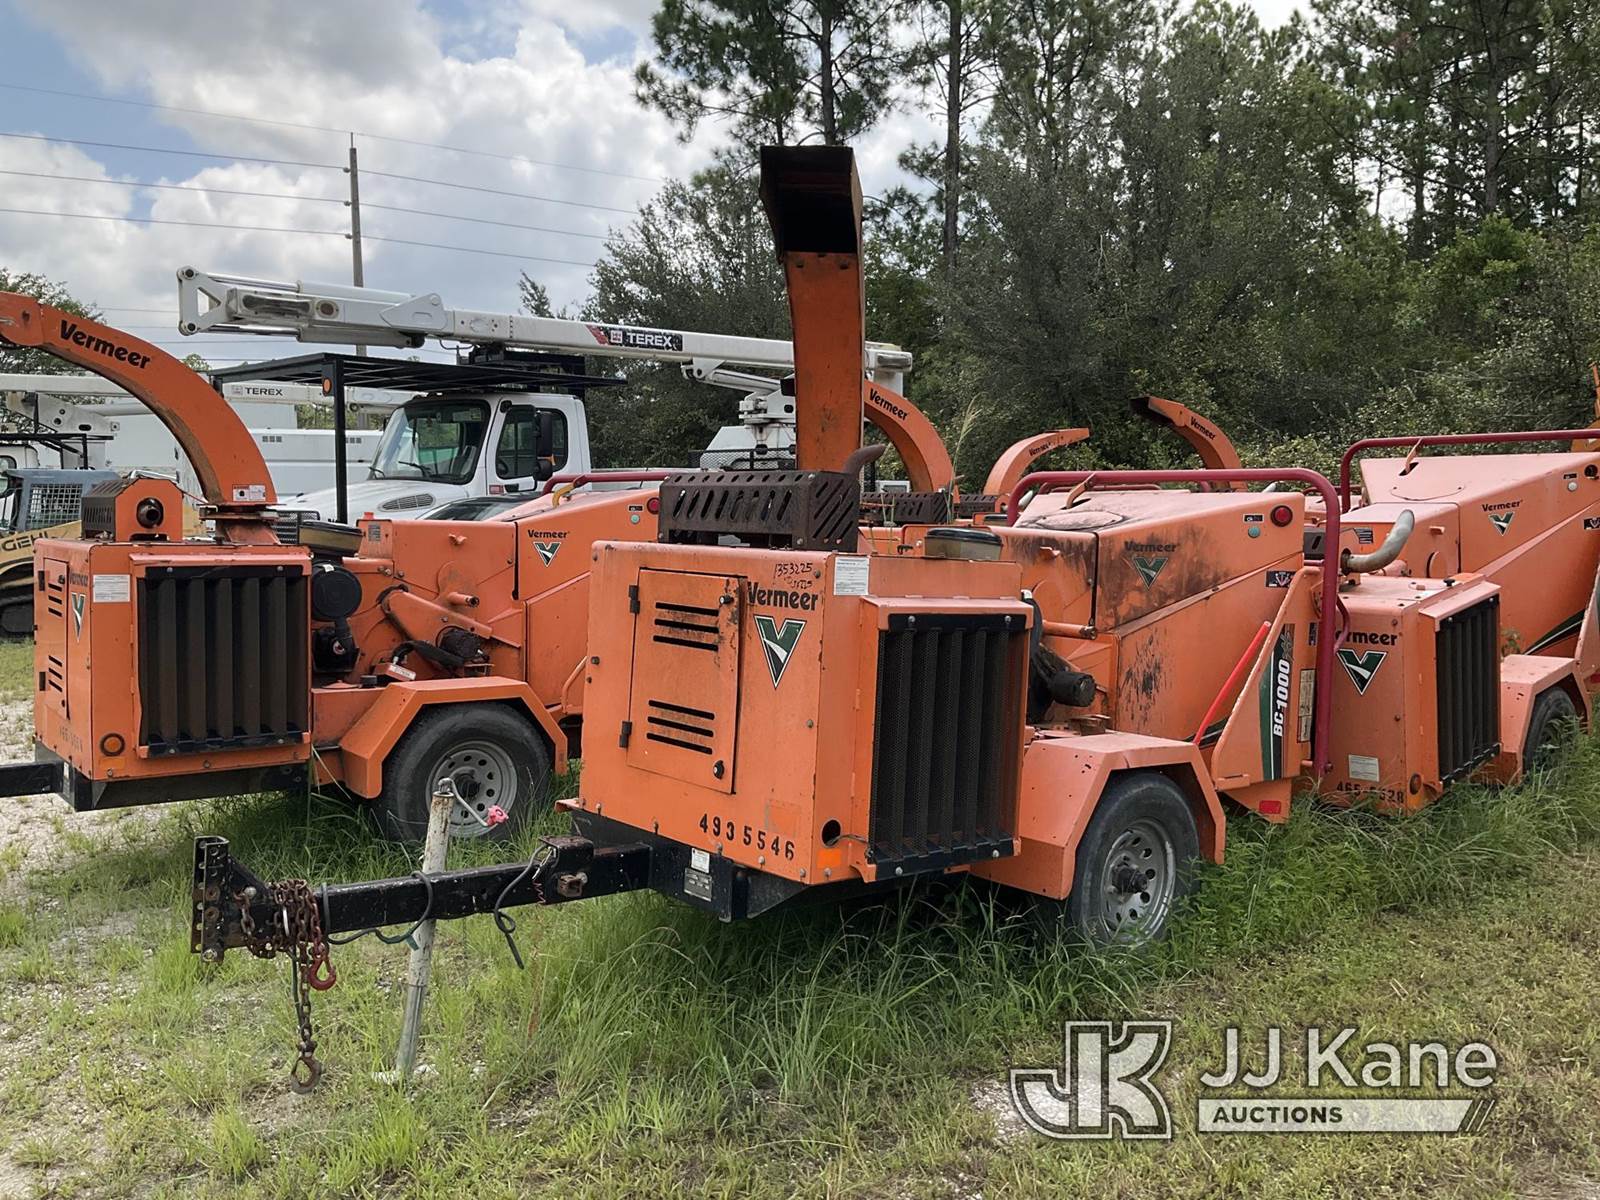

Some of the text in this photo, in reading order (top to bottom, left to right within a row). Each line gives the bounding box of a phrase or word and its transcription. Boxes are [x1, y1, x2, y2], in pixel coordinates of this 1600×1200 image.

[59, 319, 151, 370] Vermeer
[626, 332, 673, 348] TEREX
[245, 386, 284, 397] TEREX
[870, 388, 908, 421] Vermeer
[1191, 416, 1216, 440] Vermeer
[1481, 500, 1521, 512] Vermeer
[527, 529, 568, 539] Vermeer
[1124, 540, 1177, 553] Vermeer
[746, 581, 818, 611] Vermeer
[700, 813, 795, 861] 4935546
